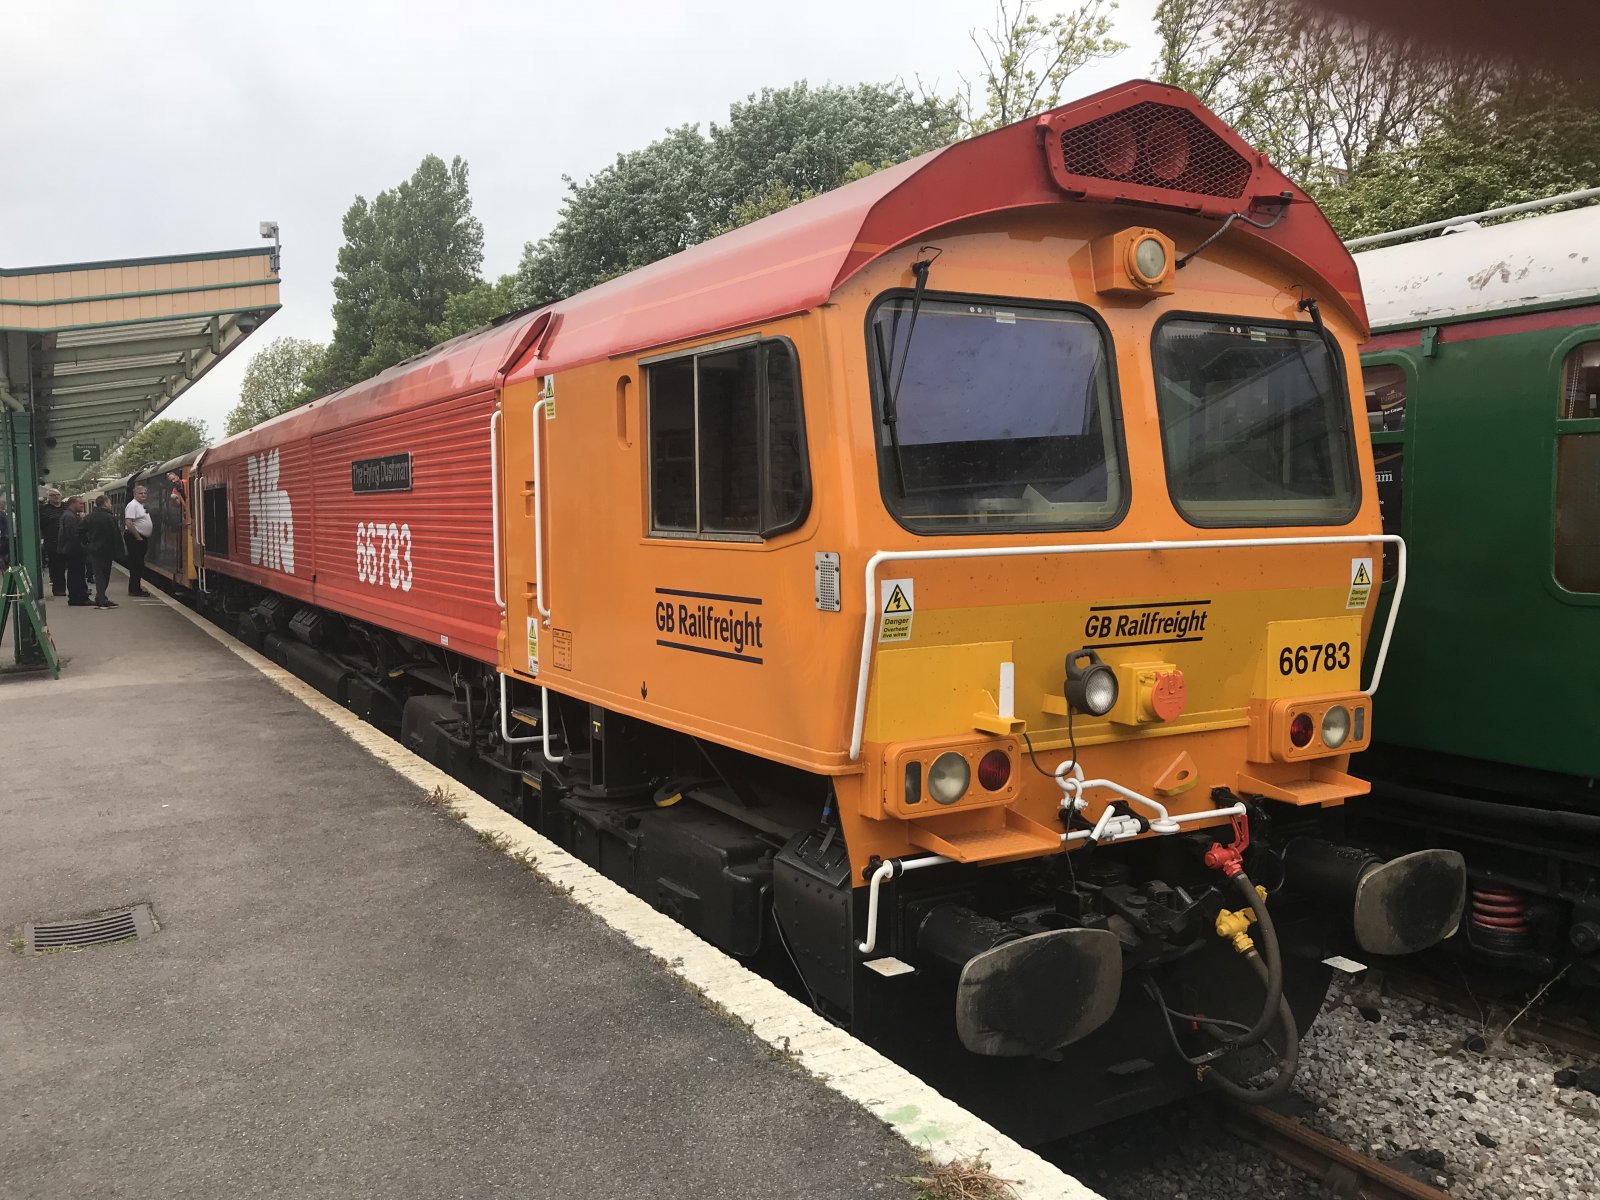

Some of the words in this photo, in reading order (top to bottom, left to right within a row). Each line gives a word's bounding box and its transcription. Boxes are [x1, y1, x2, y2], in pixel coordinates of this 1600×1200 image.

[82, 449, 91, 460] 2
[352, 464, 363, 485] The
[363, 462, 380, 487] Flying
[380, 459, 409, 482] Dustman
[356, 521, 413, 592] 66783
[656, 601, 675, 633] GB
[678, 604, 763, 654] Railfreight
[1085, 615, 1112, 639] GB
[1115, 609, 1208, 638] Railfreight
[1279, 641, 1351, 676] 66783
